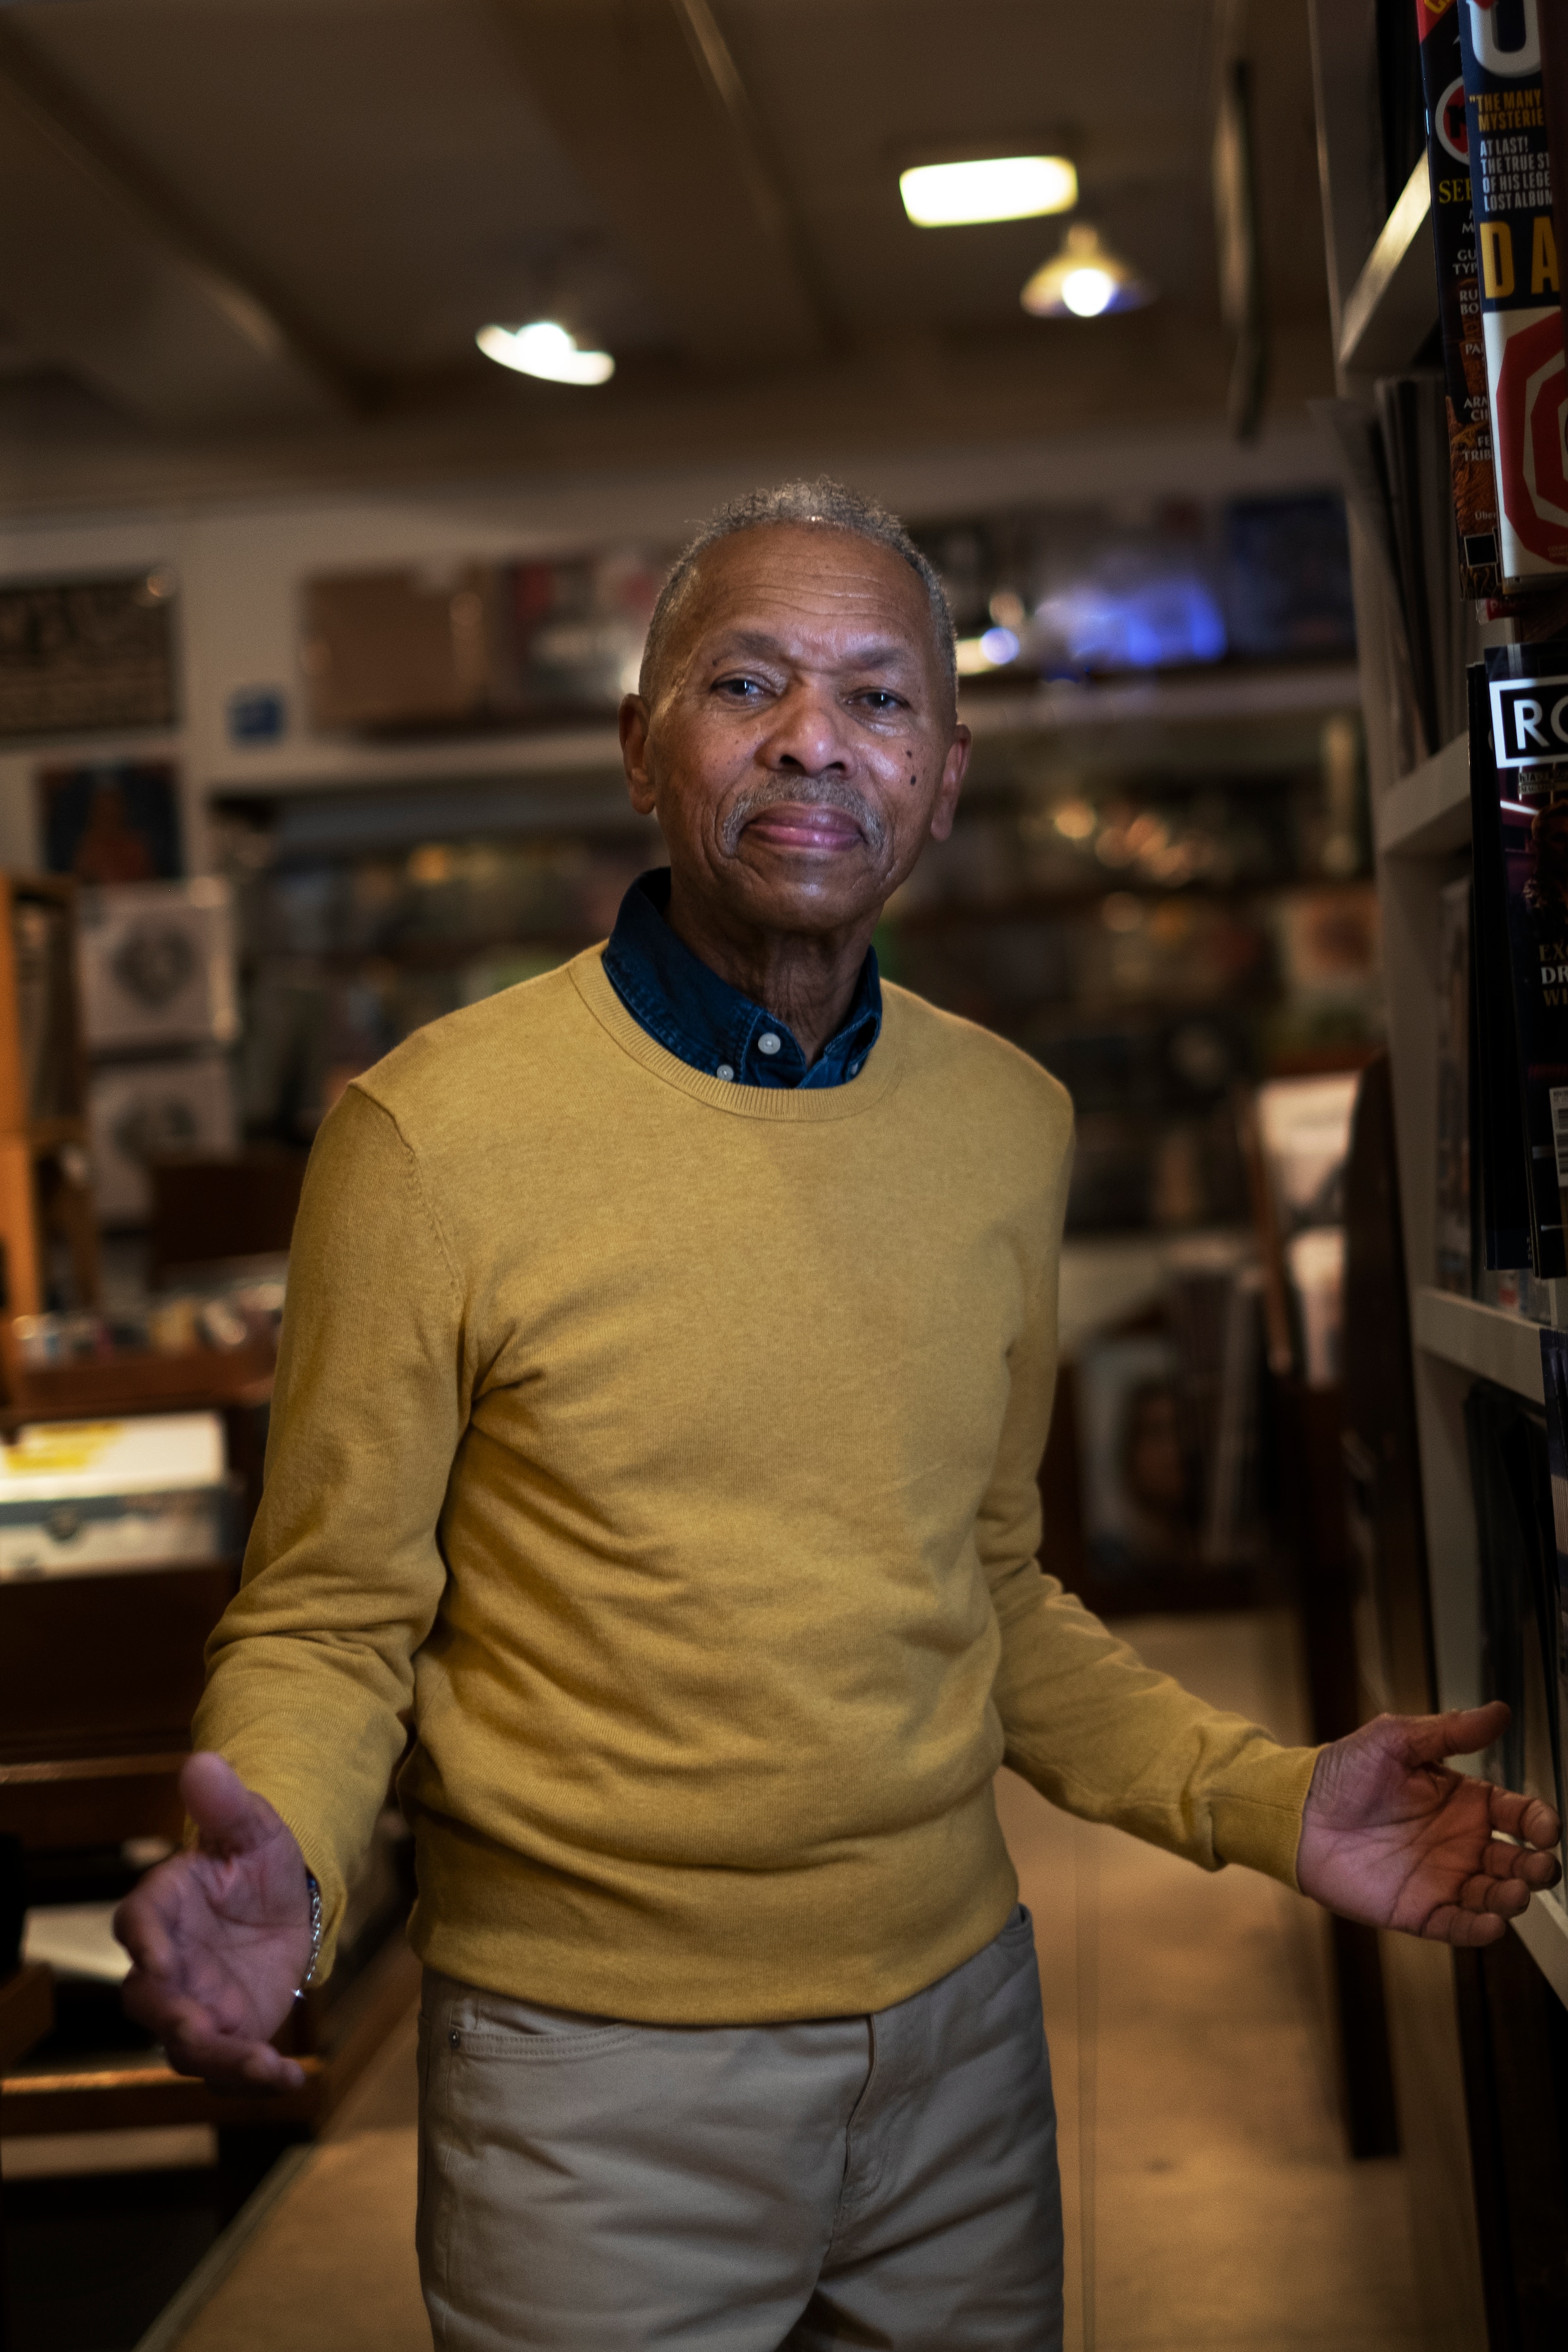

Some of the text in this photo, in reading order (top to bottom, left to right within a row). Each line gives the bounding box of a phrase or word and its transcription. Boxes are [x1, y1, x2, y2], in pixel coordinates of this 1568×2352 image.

[1469, 88, 1541, 112] "THE MANY
[1478, 108, 1545, 133] MYSTERIE
[1480, 135, 1529, 157] AT LAST!
[1481, 158, 1503, 176] THE
[1505, 153, 1534, 172] TRUE
[1483, 171, 1550, 194] OF HIS LEGE
[1483, 192, 1512, 212] LOST
[1459, 289, 1478, 302] RU
[1461, 302, 1479, 315] BO
